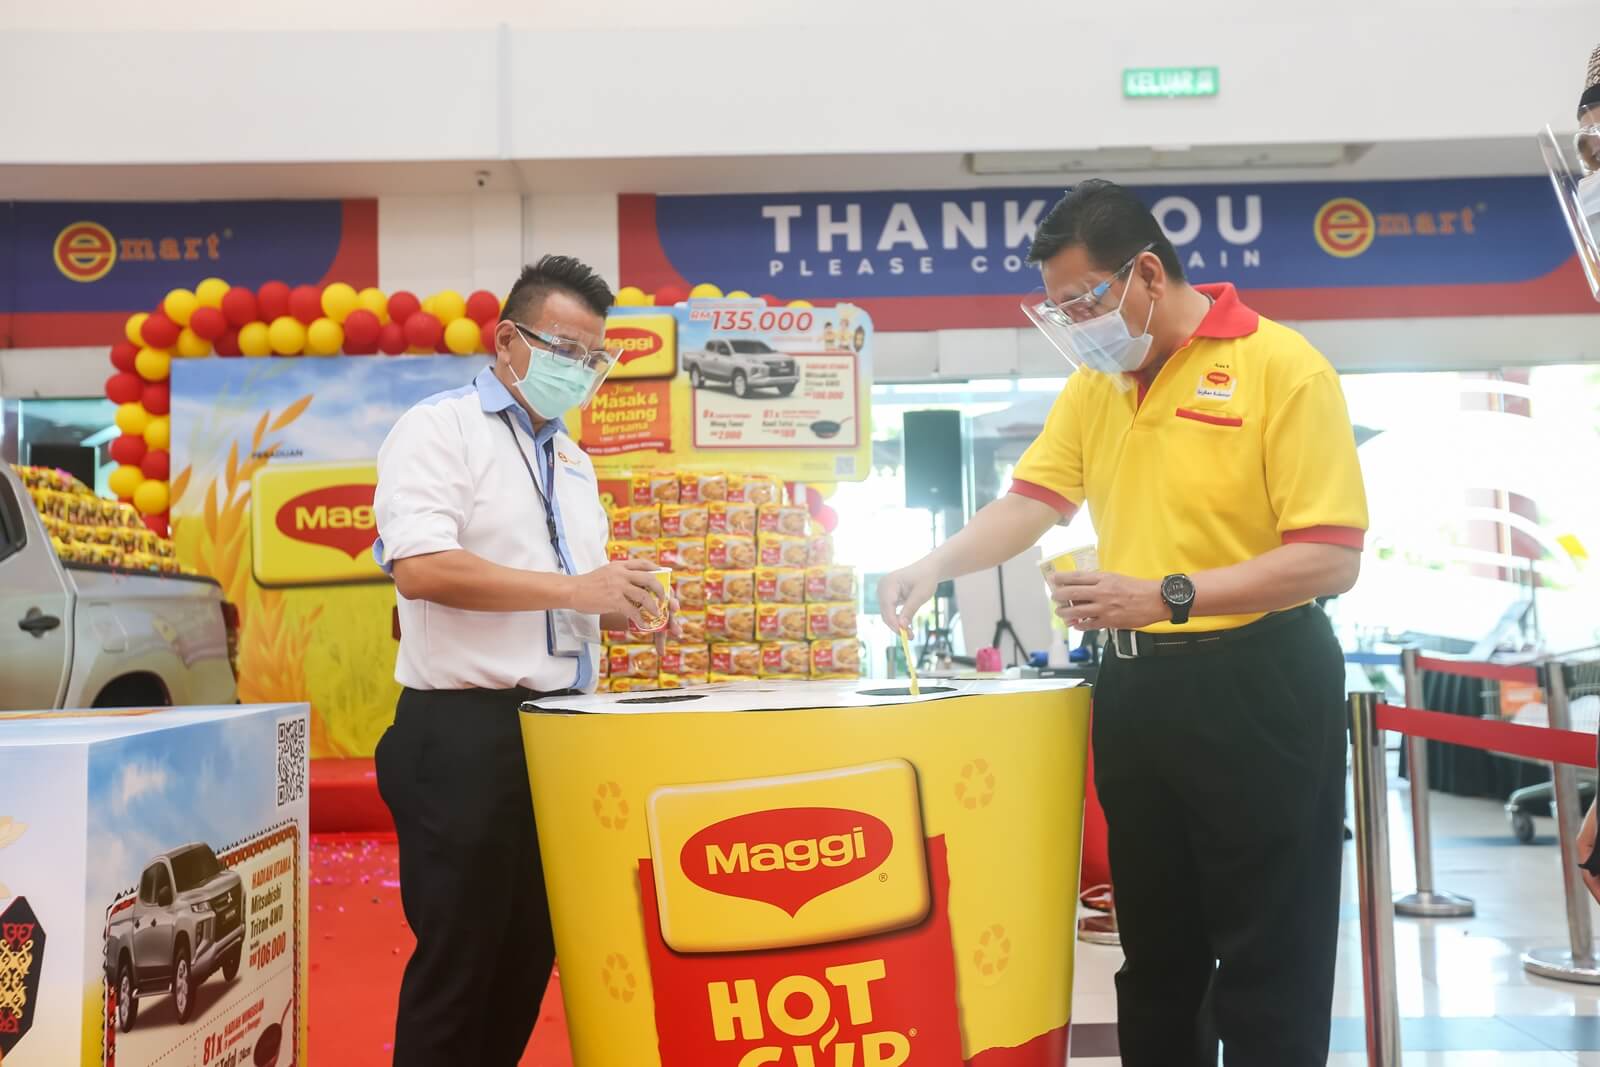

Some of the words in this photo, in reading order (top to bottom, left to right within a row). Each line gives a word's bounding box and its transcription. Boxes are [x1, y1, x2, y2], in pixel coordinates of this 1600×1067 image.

[1151, 195, 1262, 246] OU
[769, 256, 933, 277] PLEASE
[971, 255, 1022, 274] CO
[1187, 250, 1260, 268] AIN
[592, 392, 648, 410] Masak
[592, 407, 657, 424] Menang
[295, 505, 376, 531] Mag
[705, 826, 866, 875] Maggi
[251, 882, 282, 916] Mitsubishi
[250, 917, 269, 940] Triton
[707, 959, 887, 1042] HOT
